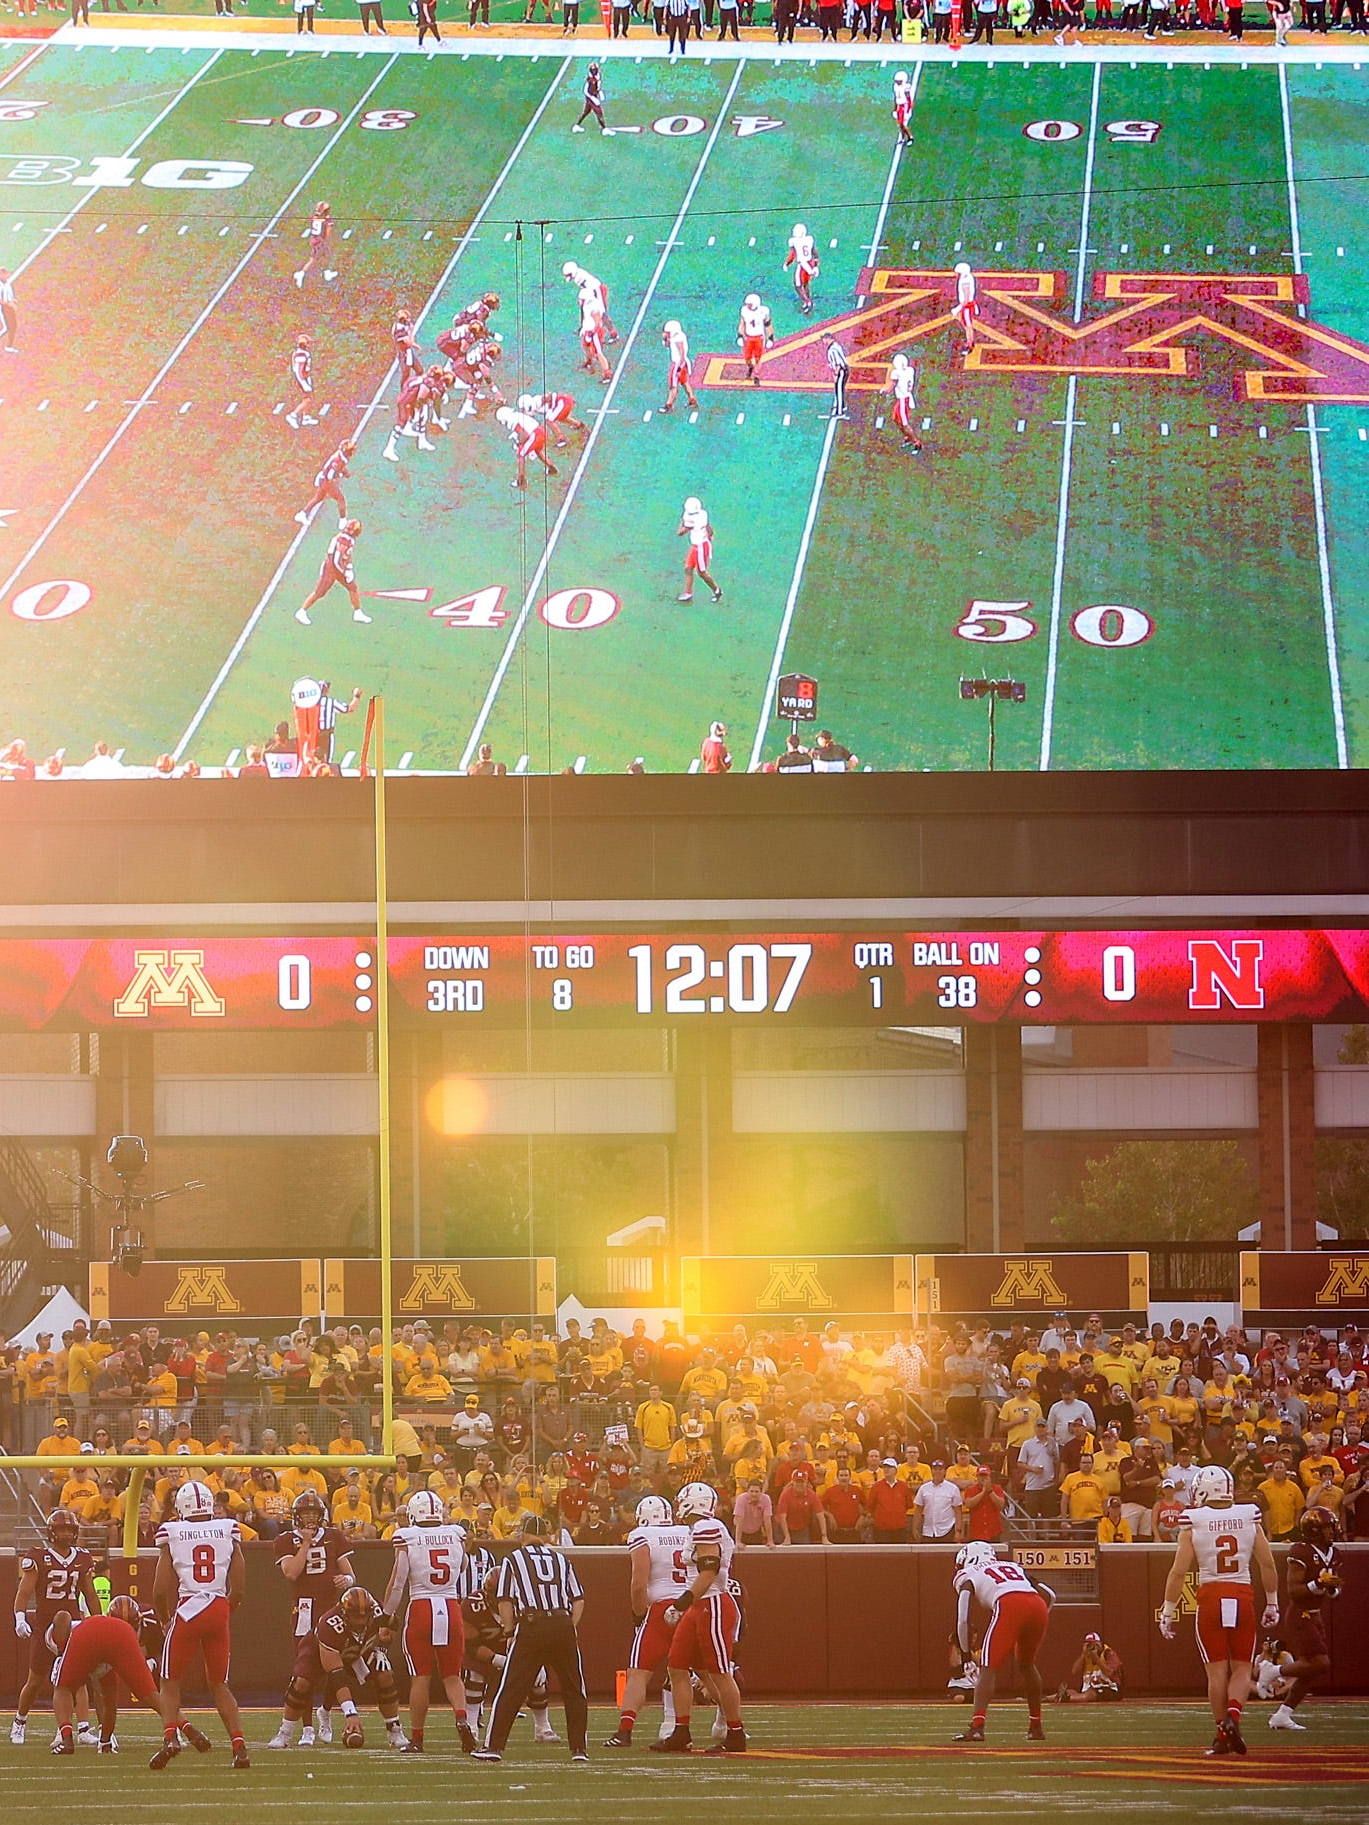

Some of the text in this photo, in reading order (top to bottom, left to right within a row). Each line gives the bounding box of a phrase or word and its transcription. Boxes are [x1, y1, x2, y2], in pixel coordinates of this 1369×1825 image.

[952, 599, 1155, 648] 50
[781, 697, 814, 709] YARD
[424, 945, 594, 970] DOWN TO GO
[854, 942, 999, 967] QTR BALL ON
[278, 954, 311, 1010] 0
[627, 943, 813, 1014] 12:07
[1102, 945, 1135, 1001] 0
[1188, 940, 1264, 1009] N
[427, 979, 573, 1012] 3RD 8
[869, 975, 977, 1008] 1 38
[179, 1528, 224, 1542] SINGLETON
[417, 1535, 454, 1546] J. BULLOCK
[1208, 1518, 1243, 1532] GIFFORD
[658, 1536, 687, 1546] ROBINS
[1215, 1534, 1239, 1574] 2
[192, 1544, 216, 1583] 8
[429, 1549, 450, 1585] 5
[535, 1554, 554, 1581] U
[1017, 1552, 1045, 1565] 150
[1064, 1552, 1091, 1565] 151
[46, 1569, 80, 1600] 21
[984, 1566, 1024, 1584] 18
